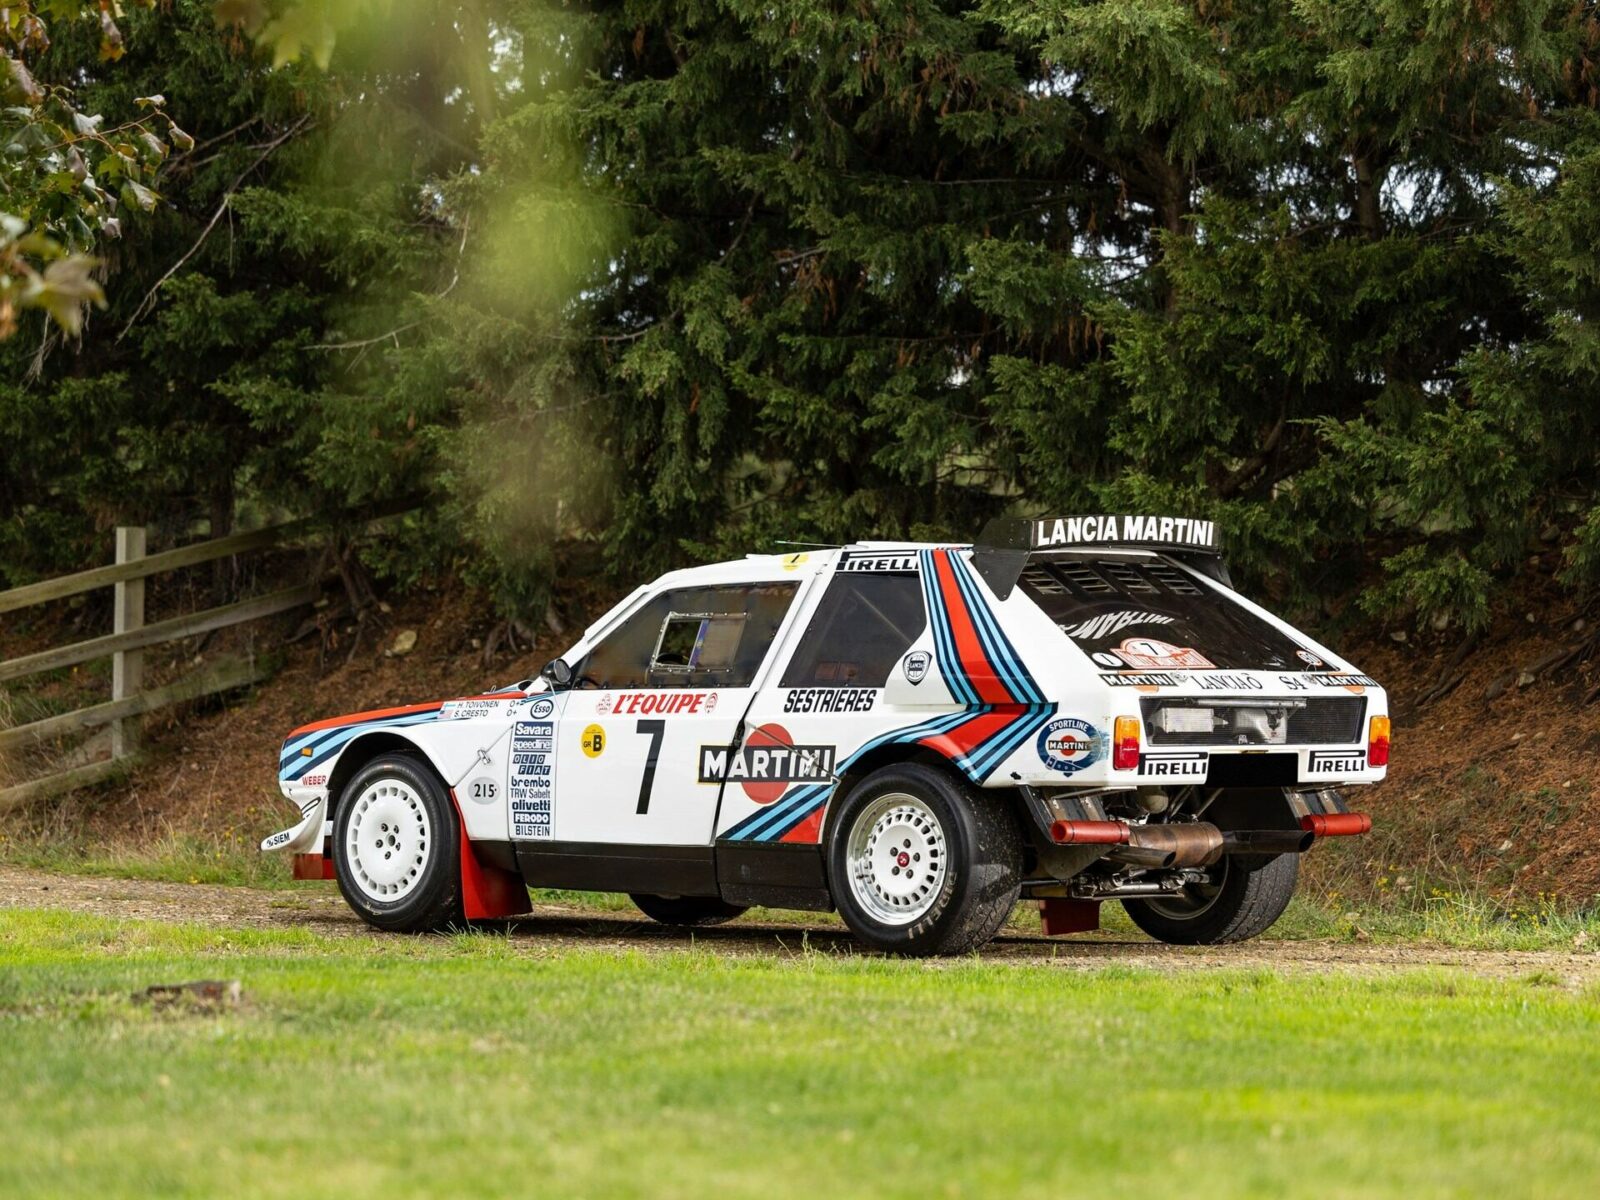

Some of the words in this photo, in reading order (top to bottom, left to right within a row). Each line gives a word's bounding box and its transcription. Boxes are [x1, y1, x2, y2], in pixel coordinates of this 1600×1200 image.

[1037, 516, 1118, 546] LANCIA
[1123, 515, 1214, 547] MARTINI
[1140, 642, 1159, 656] 7
[1104, 674, 1176, 686] MARTINI
[1190, 675, 1253, 690] LANCIA
[1278, 675, 1309, 690] S4
[1315, 675, 1376, 686] MARTINI
[466, 700, 500, 708] TOIVONEN
[783, 689, 877, 713] SESTRIERES
[462, 709, 489, 718] CRESTO
[516, 723, 552, 736] Savara
[1049, 719, 1089, 732] SPORTLINE
[593, 734, 602, 752] B
[513, 754, 546, 764] OLIO
[703, 749, 831, 779] MARTINI
[1138, 752, 1209, 775] PIRELLI
[1308, 750, 1366, 772] PIRELLI
[518, 765, 551, 775] FIAT
[636, 719, 666, 815] 7
[302, 775, 327, 786] WEBER
[511, 776, 551, 788] brembo
[510, 788, 528, 799] TRW
[529, 788, 551, 799] Sabelt
[512, 800, 551, 811] olivetti
[514, 813, 549, 824] FERODO
[515, 825, 550, 837] BILSTEIN
[274, 832, 291, 845] SIEM
[908, 871, 958, 940] PIRELLI
